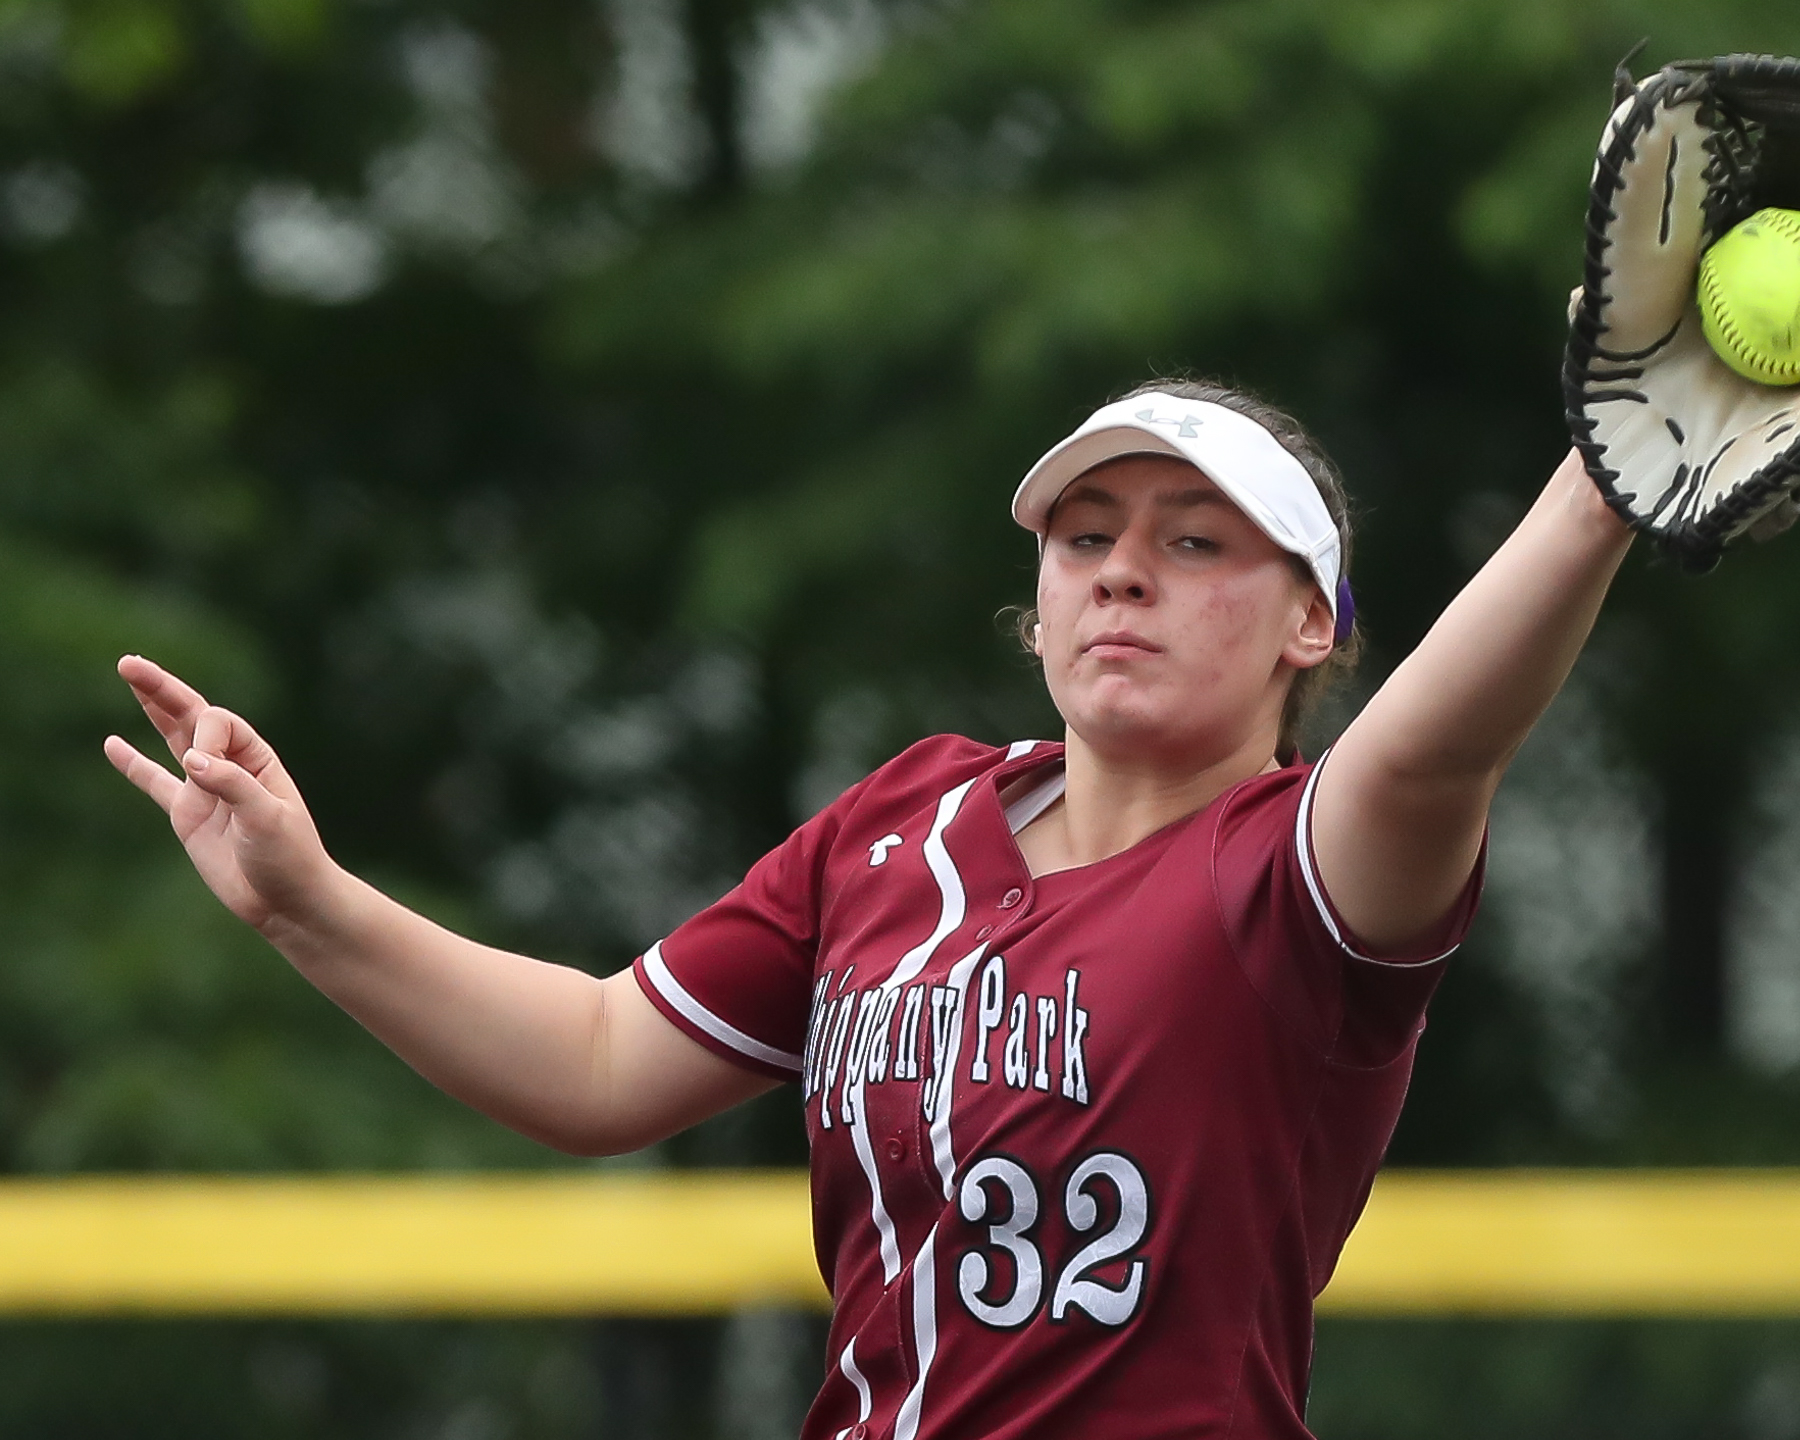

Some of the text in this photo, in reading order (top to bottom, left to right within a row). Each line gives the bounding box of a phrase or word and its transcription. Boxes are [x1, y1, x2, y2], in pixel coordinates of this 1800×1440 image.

[804, 954, 1089, 1130] hippany Park
[956, 1149, 1150, 1328] 32
